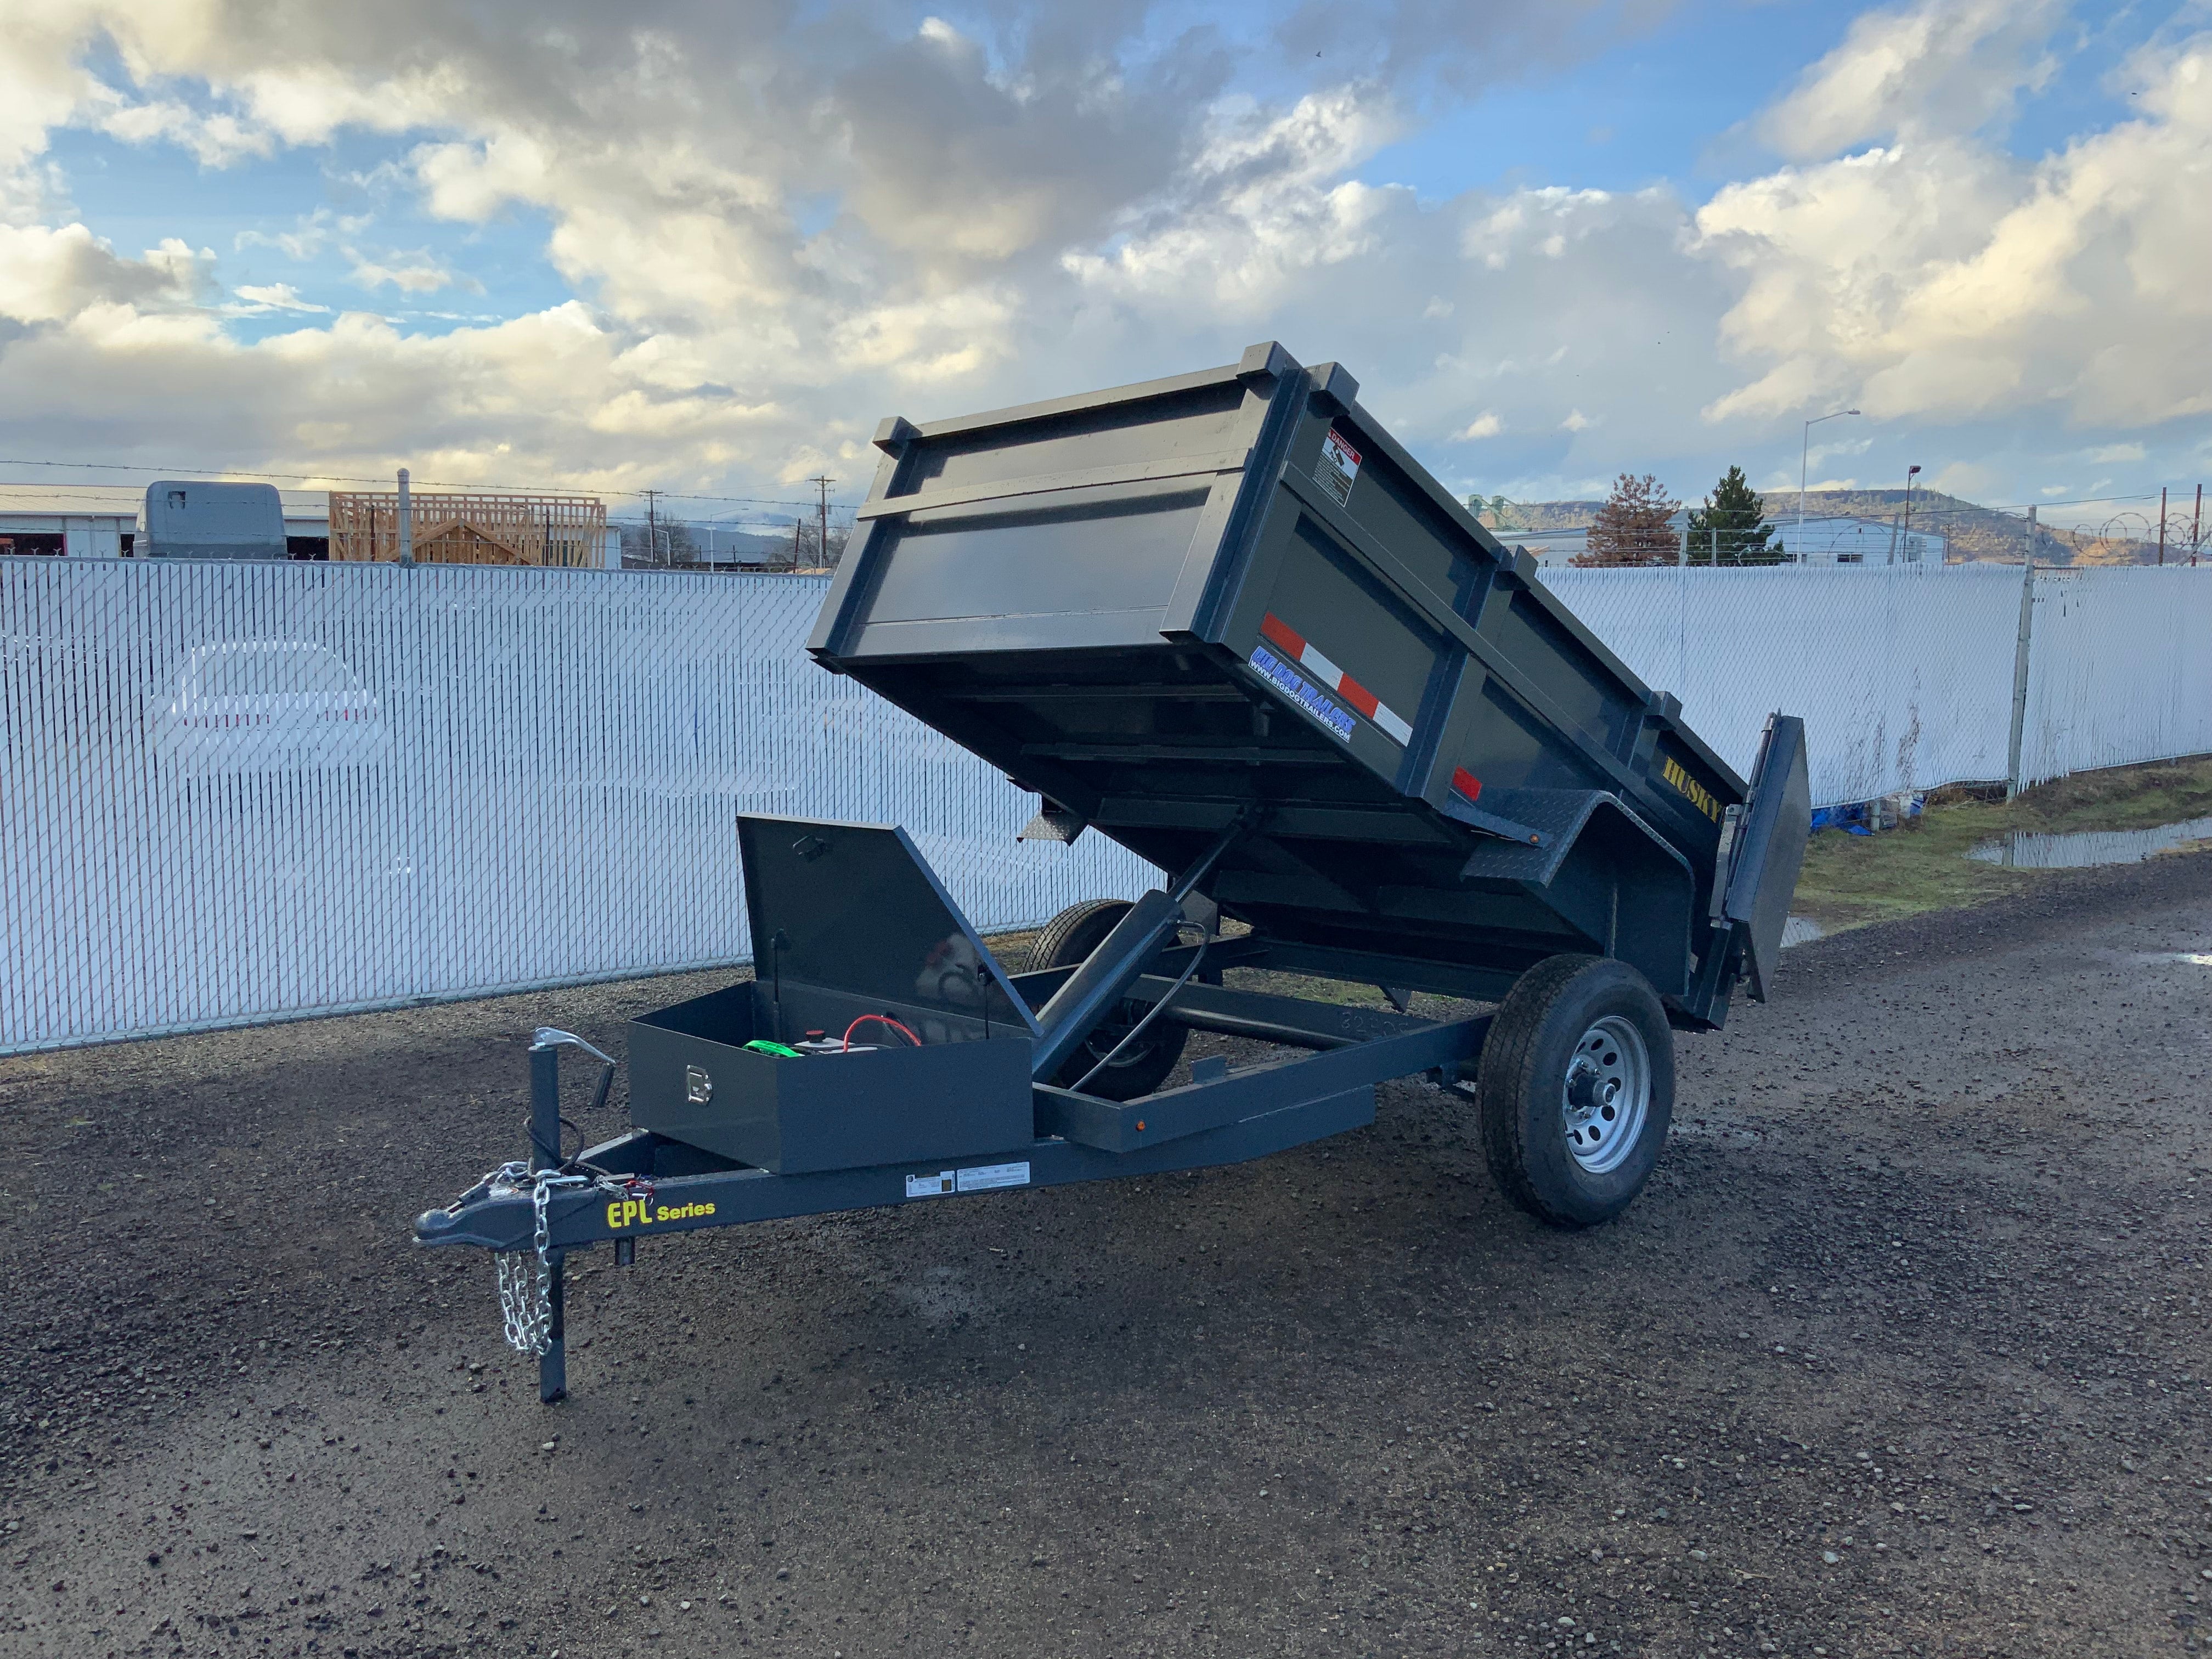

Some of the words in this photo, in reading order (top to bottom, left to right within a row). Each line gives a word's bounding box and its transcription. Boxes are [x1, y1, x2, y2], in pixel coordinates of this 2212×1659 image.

[1331, 434, 1355, 460] DANGER
[1250, 660, 1351, 741] WWW.BIGDOGTRAILERS.COM
[1251, 646, 1278, 672] BIG
[1272, 662, 1303, 691] DOG
[1297, 681, 1356, 733] TRAILERS
[1662, 756, 1722, 823] HUSKY
[608, 1199, 653, 1228] EPL
[657, 1202, 716, 1221] Series
